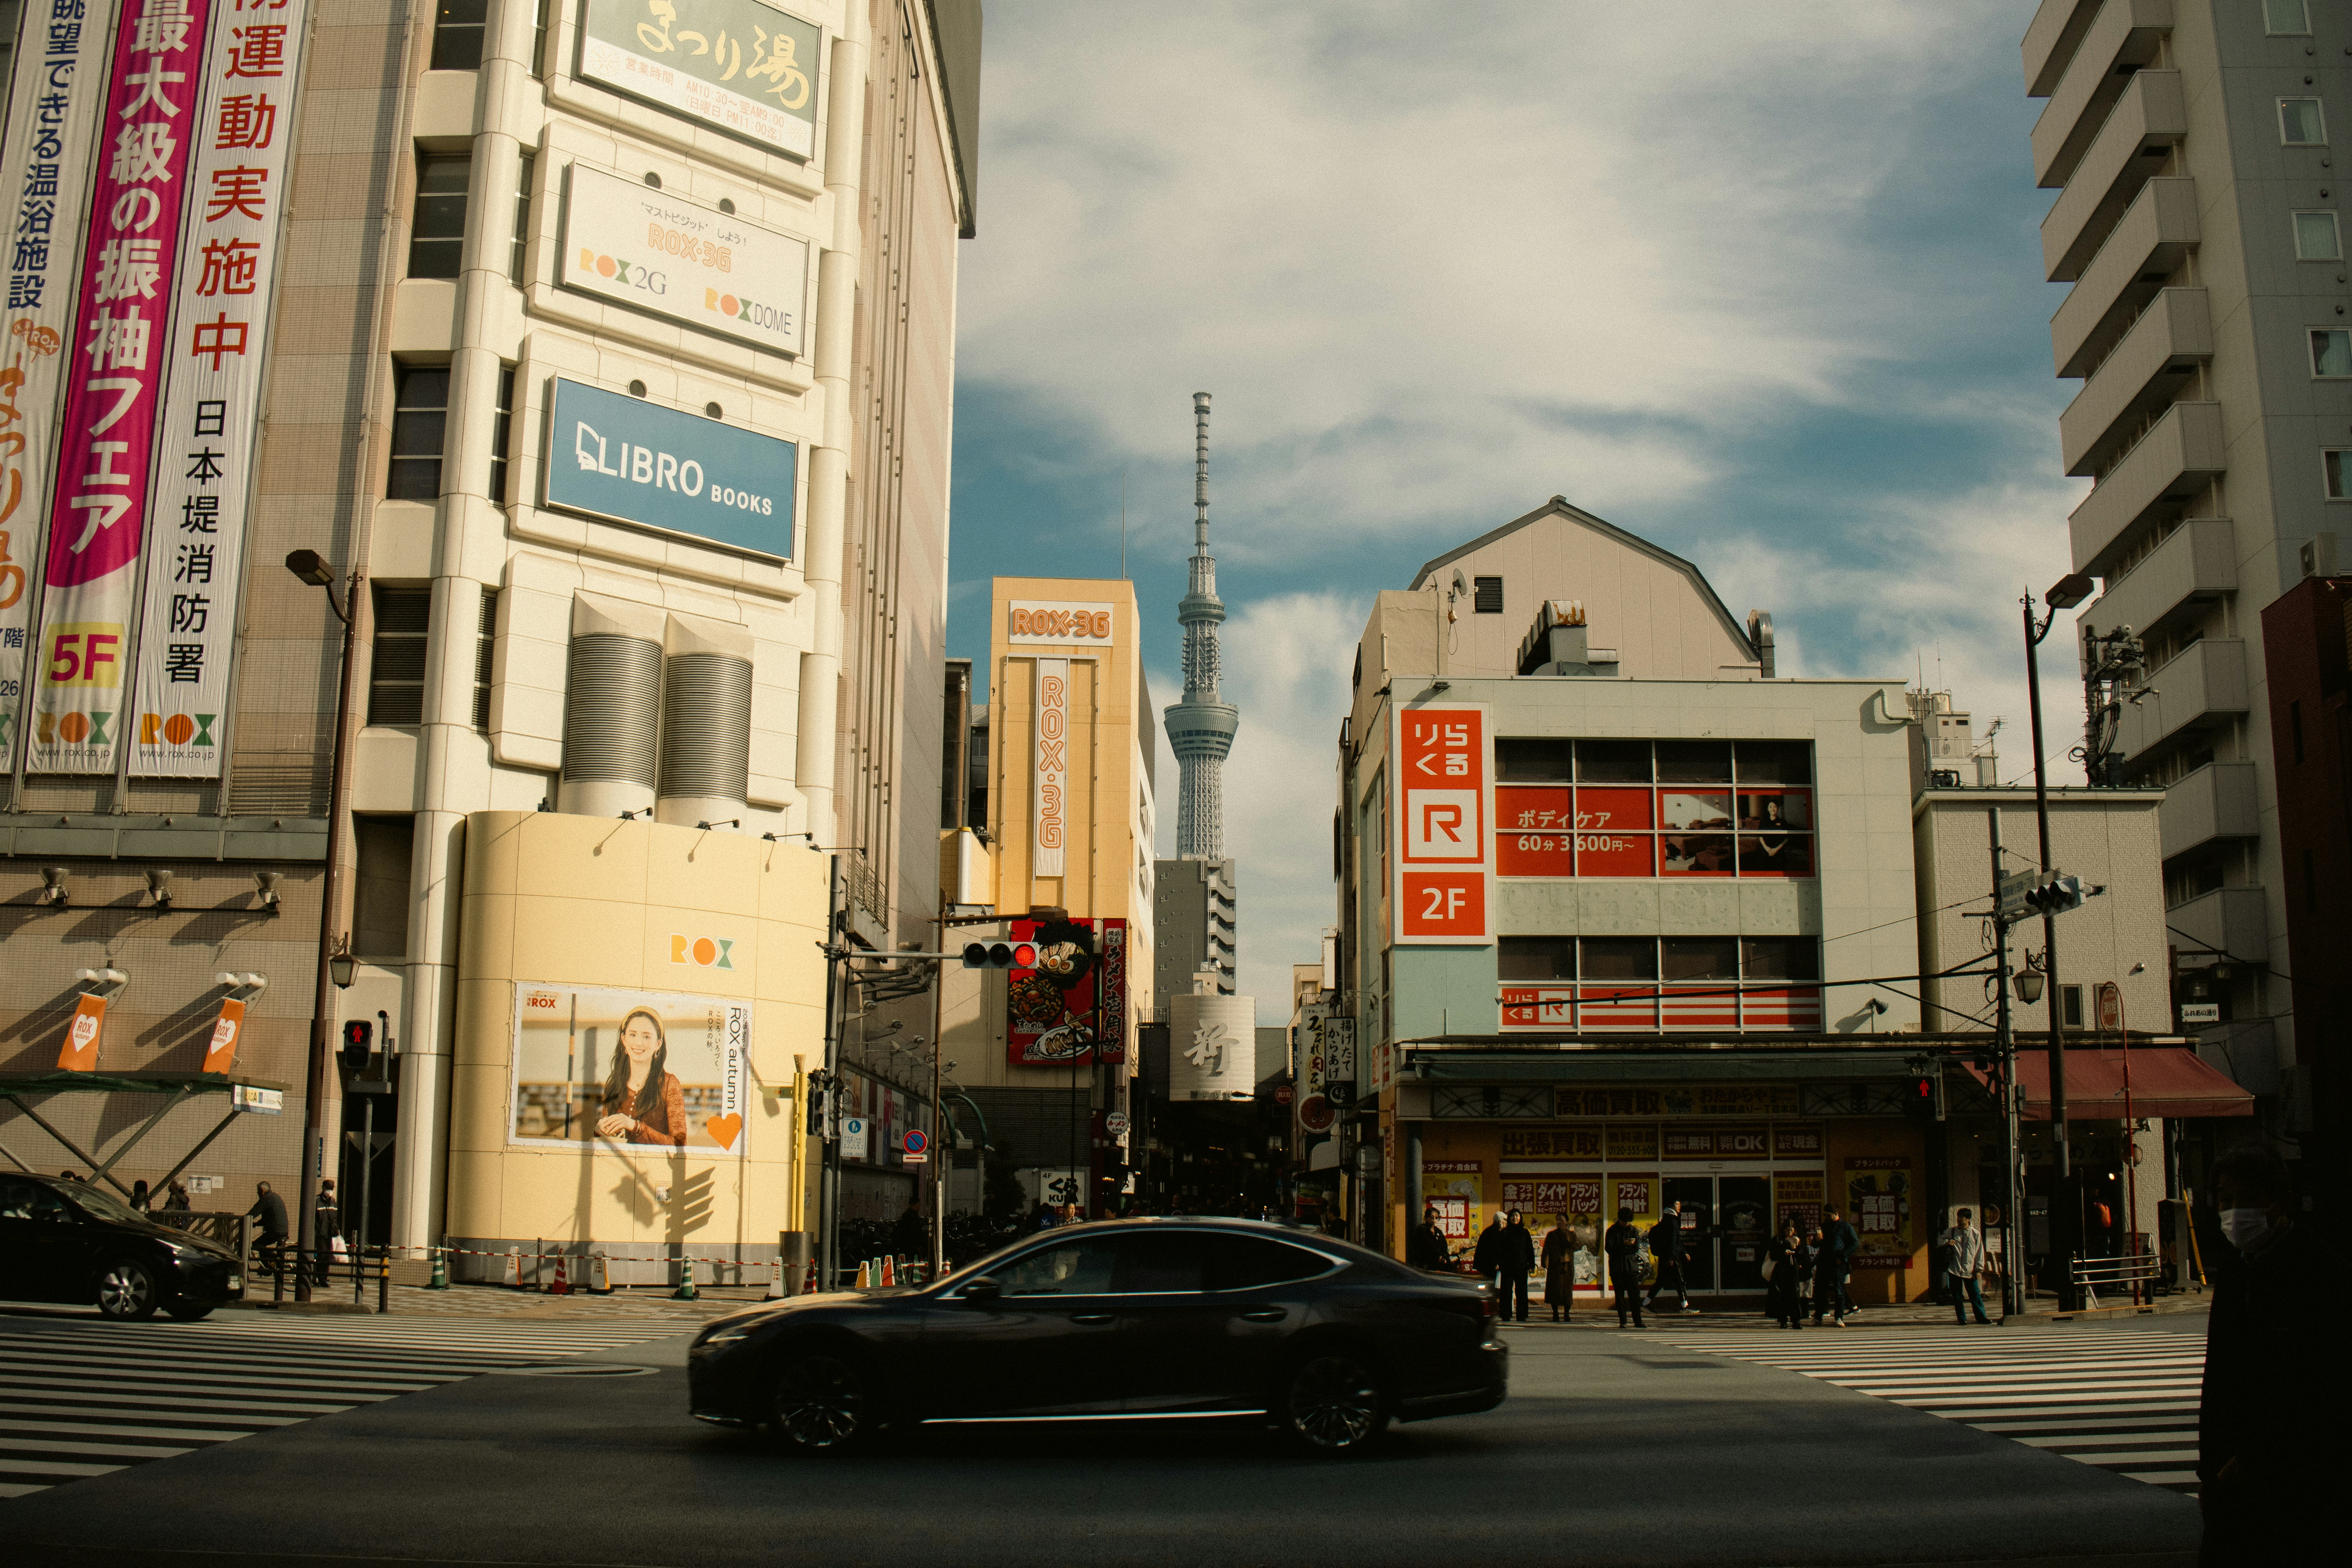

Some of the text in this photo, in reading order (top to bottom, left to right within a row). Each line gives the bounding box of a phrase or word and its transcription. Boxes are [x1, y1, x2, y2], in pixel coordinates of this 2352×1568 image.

[637, 0, 809, 110] まつり湯
[626, 58, 673, 86] 営業時間
[580, 247, 667, 295] ROX 2G
[705, 286, 792, 336] ROX DOME
[165, 0, 289, 683] 運動実施中 日本堤消防署
[598, 436, 773, 515] LIBRO BOOKS
[50, 633, 118, 682] 5F
[38, 711, 113, 745] ROX
[140, 713, 218, 746] ROX
[38, 747, 111, 759] www.rox.co.jp
[140, 748, 215, 760] www.rox.co.jp
[1423, 804, 1462, 842] R
[1518, 810, 1611, 829] ボディケア
[1421, 887, 1466, 920] 2F
[670, 933, 736, 971] ROX
[532, 998, 556, 1009] ROX
[1546, 997, 1564, 1016] R
[2183, 1008, 2217, 1017] ふれあい通り
[76, 1021, 93, 1034] ROX
[215, 1025, 230, 1037] ROX
[1328, 1027, 1340, 1079] からあげ
[1339, 1020, 1352, 1072] 揚げたて
[727, 1007, 741, 1109] ROX autumn
[1502, 1131, 1600, 1155] 出張買取
[1734, 1135, 1764, 1150] OK
[1504, 1184, 1517, 1200] 金
[1537, 1184, 1566, 1200] ダイヤ
[1570, 1183, 1599, 1198] ブランド
[1619, 1183, 1647, 1198] ブランド
[1430, 1200, 1465, 1218] 高価
[1571, 1199, 1599, 1212] バッグ
[1620, 1198, 1647, 1212] 時計
[1862, 1195, 1895, 1213] 高価
[1862, 1214, 1896, 1232] 買取
